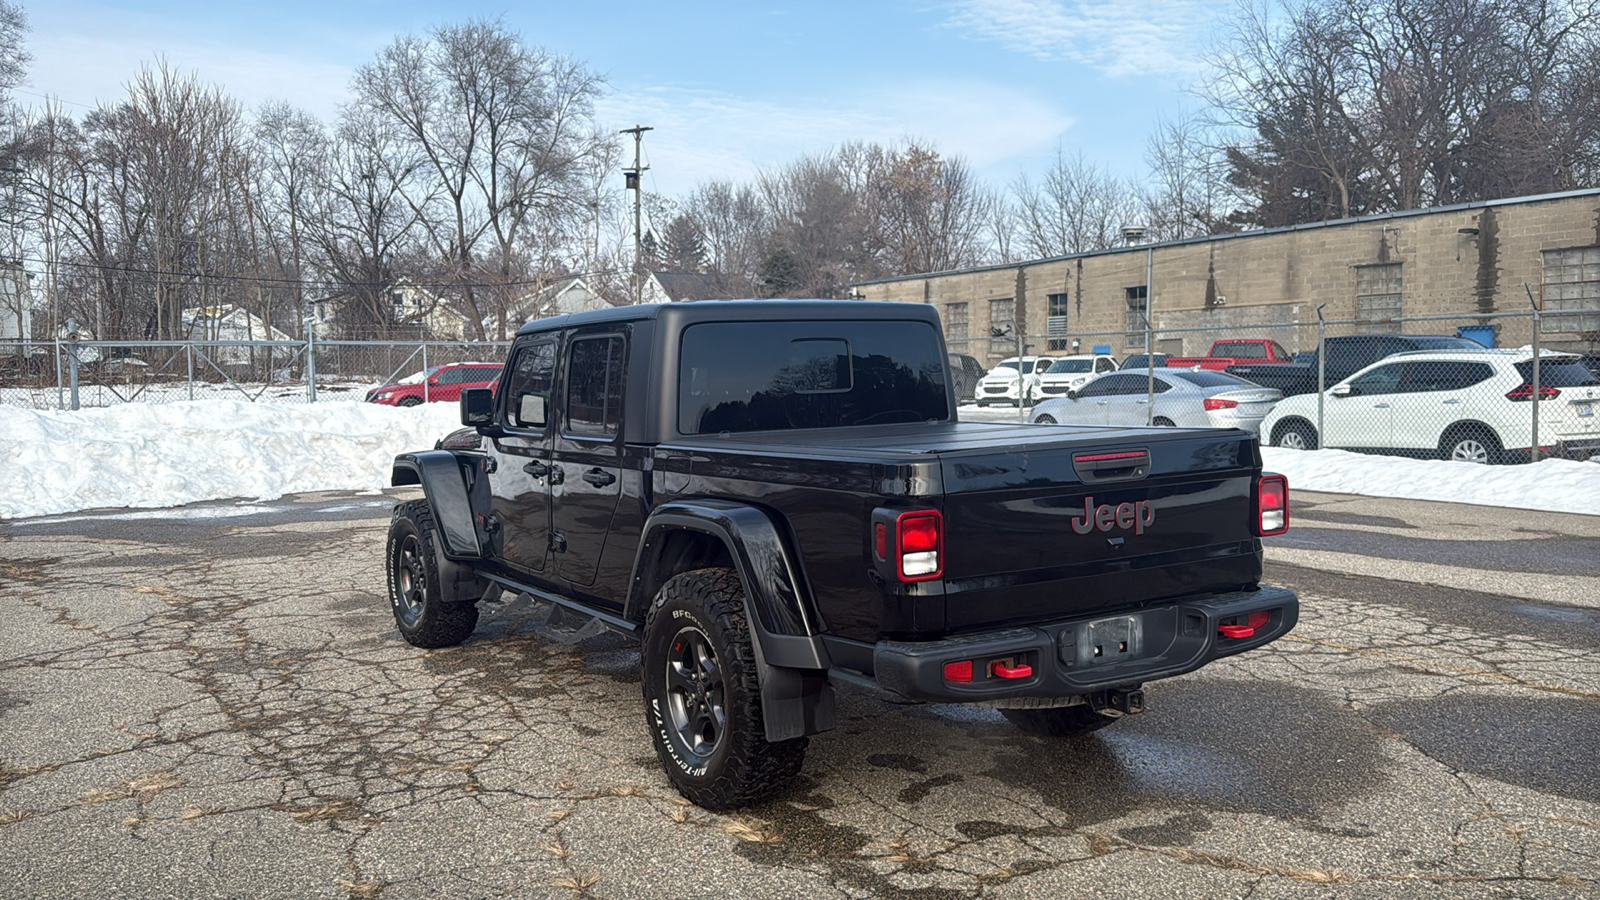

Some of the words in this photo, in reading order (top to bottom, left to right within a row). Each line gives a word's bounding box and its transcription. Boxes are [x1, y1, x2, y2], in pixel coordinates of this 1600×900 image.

[1071, 496, 1155, 535] Jeep
[652, 698, 664, 728] T/A
[660, 729, 708, 777] All-Terrain
